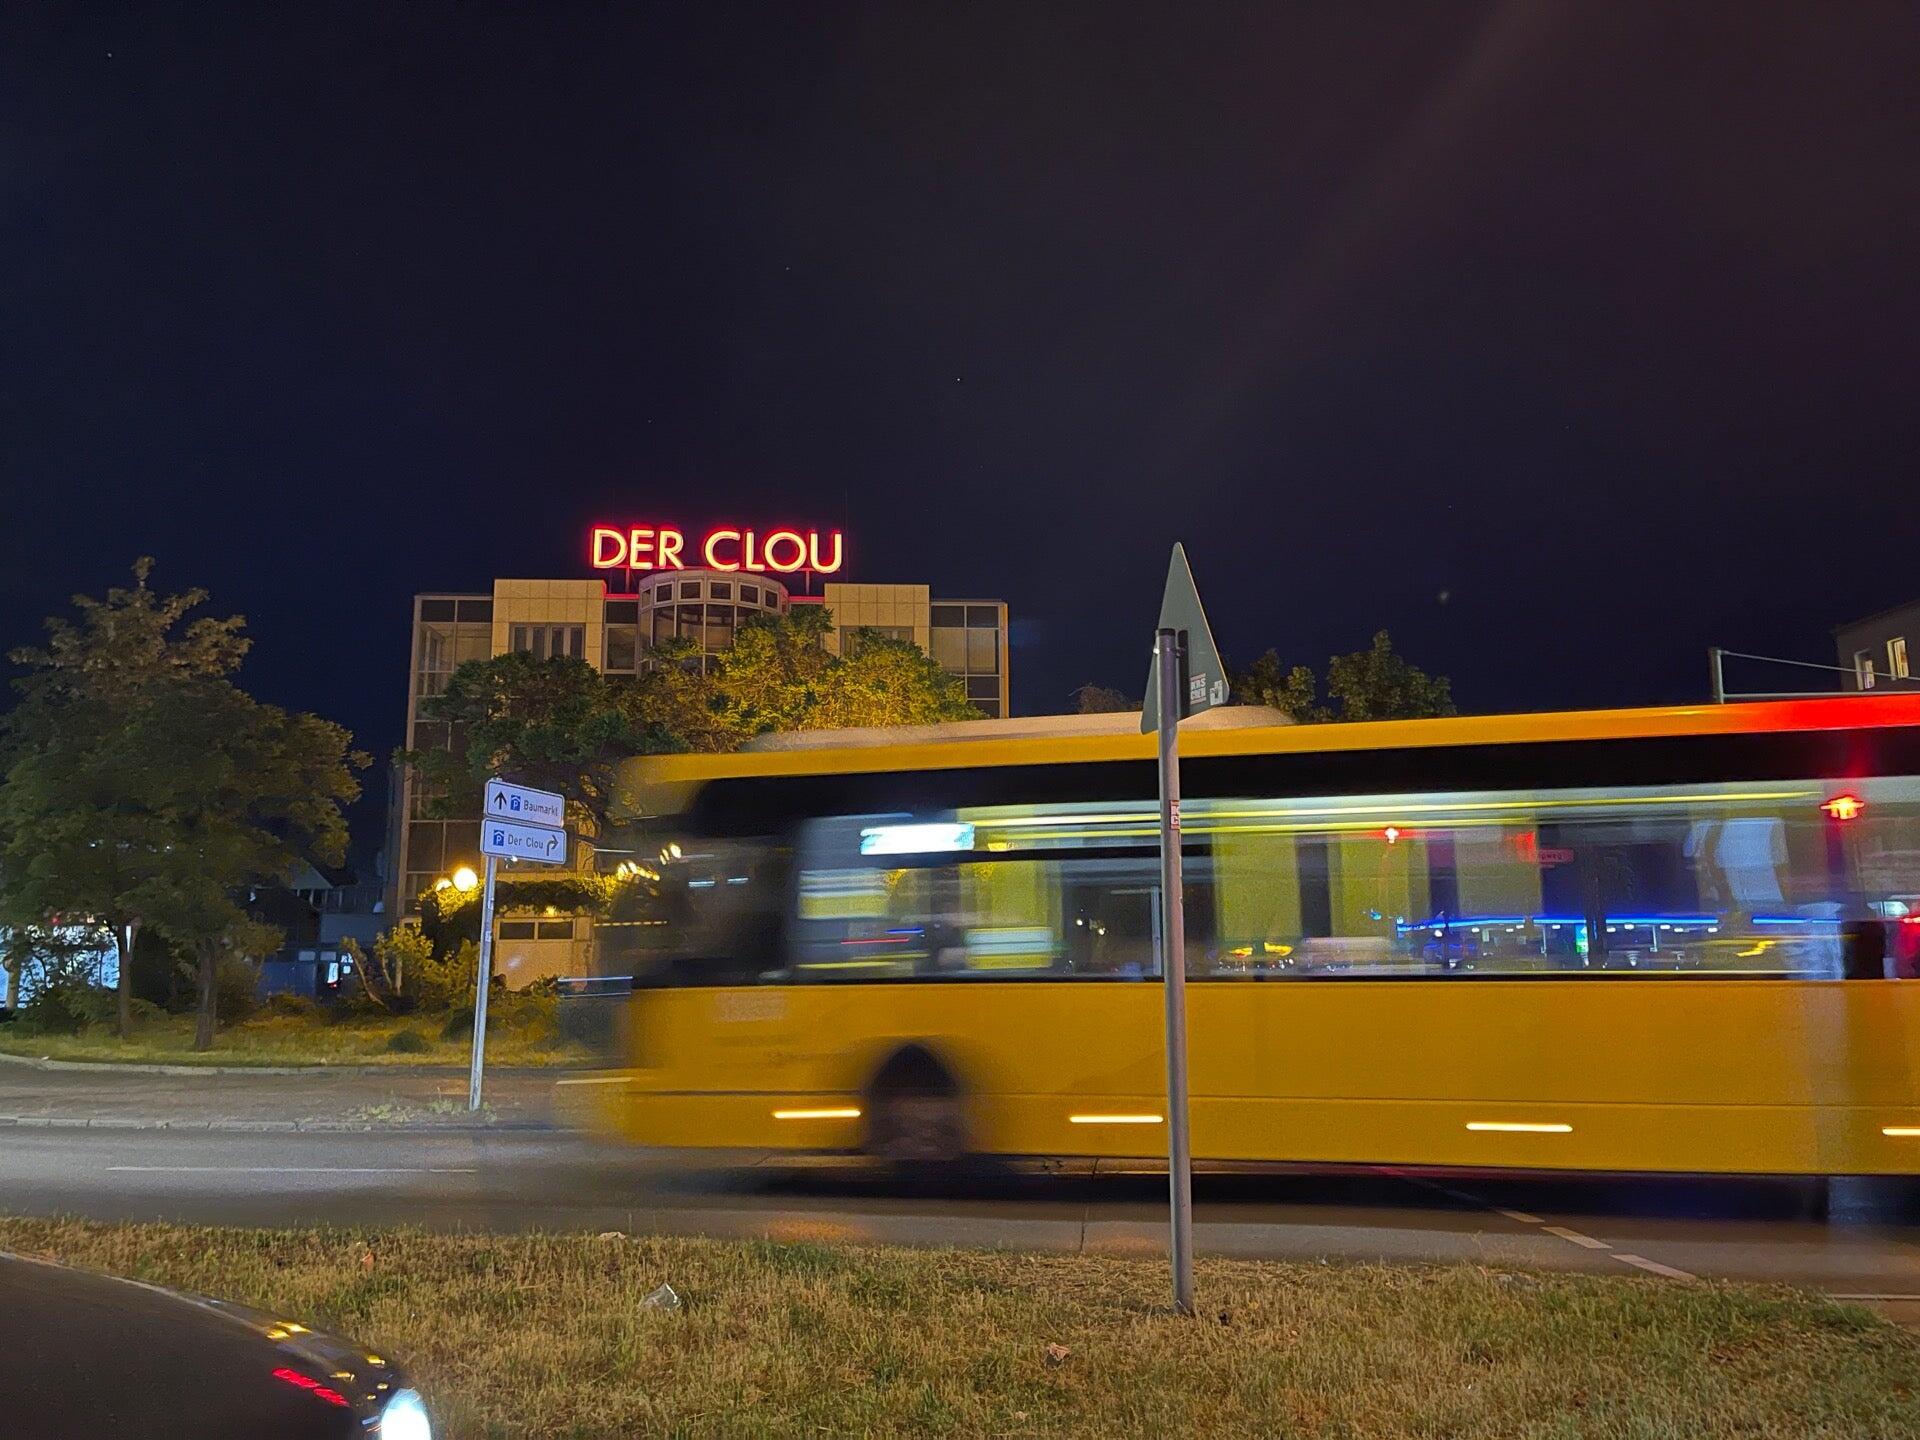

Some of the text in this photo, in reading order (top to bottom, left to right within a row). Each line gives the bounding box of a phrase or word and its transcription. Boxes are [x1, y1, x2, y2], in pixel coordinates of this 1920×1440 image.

[593, 528, 842, 573] DER CLOU
[523, 800, 558, 816] Baumarkt
[508, 835, 522, 846] Der
[526, 837, 544, 849] Clou
